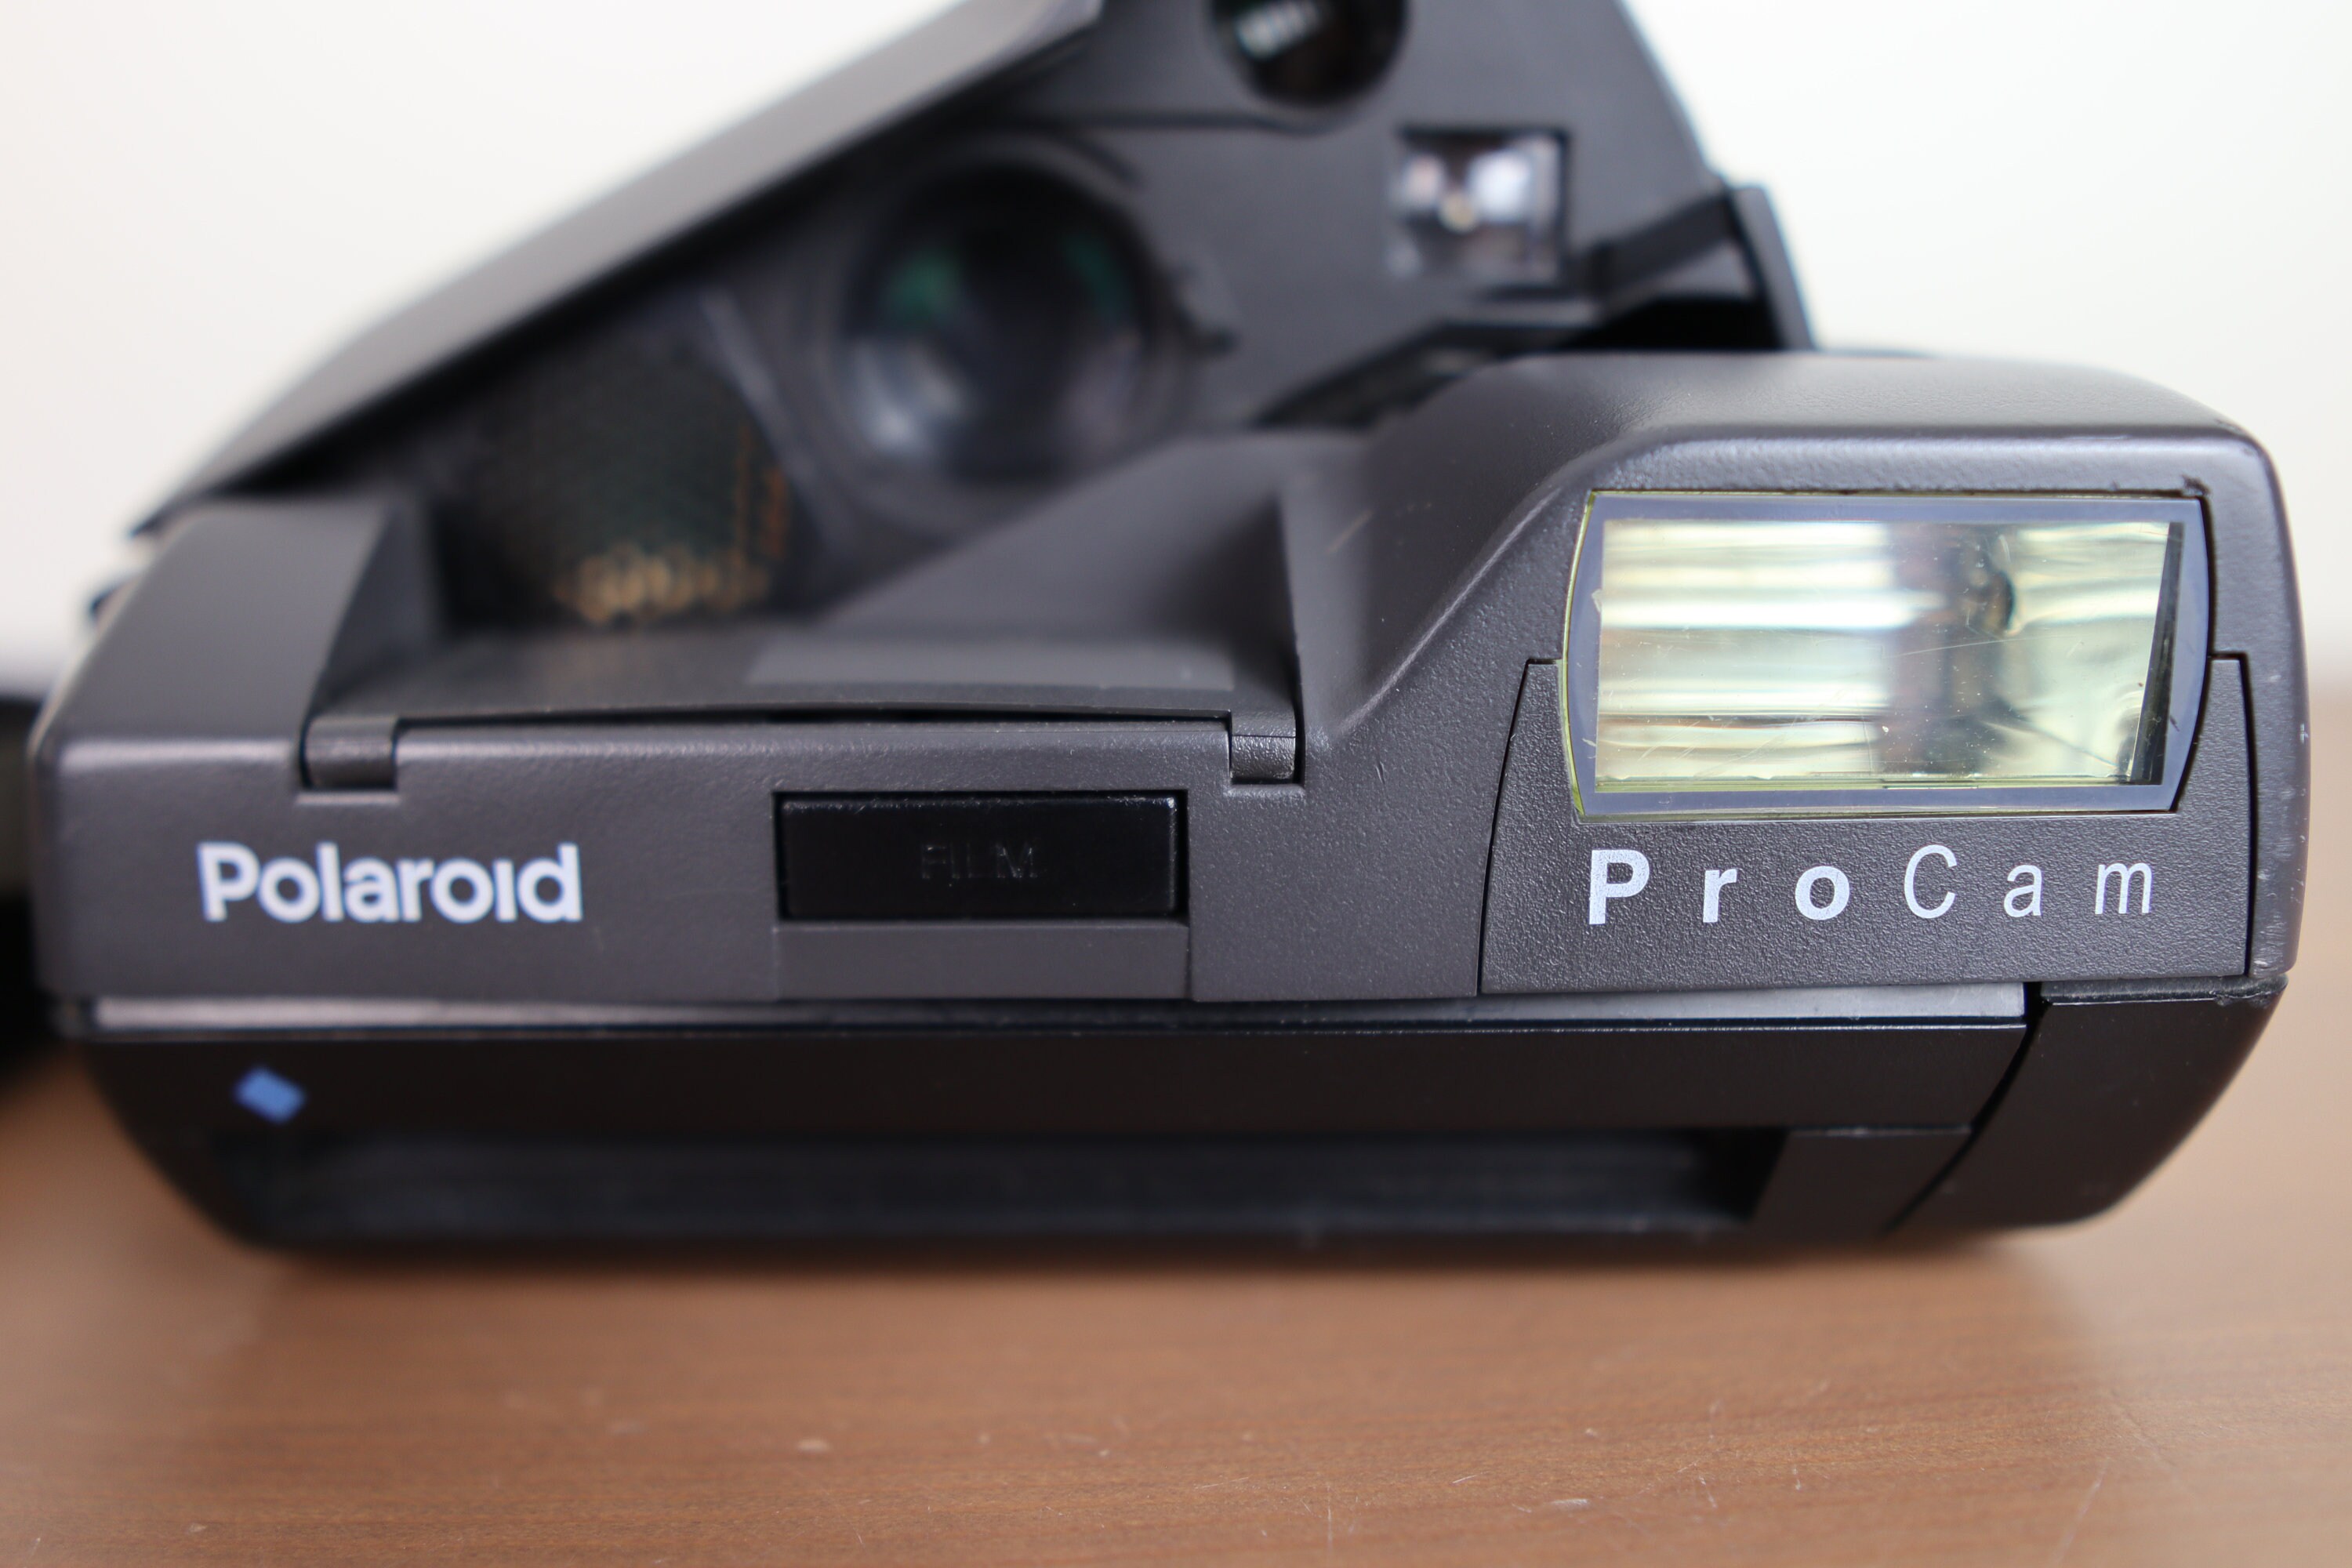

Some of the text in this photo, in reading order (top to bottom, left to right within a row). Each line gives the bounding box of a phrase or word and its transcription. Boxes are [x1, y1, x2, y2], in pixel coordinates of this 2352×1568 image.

[198, 842, 583, 923] Polaroid
[920, 842, 1037, 879] FILM
[1588, 843, 2154, 925] ProCam
